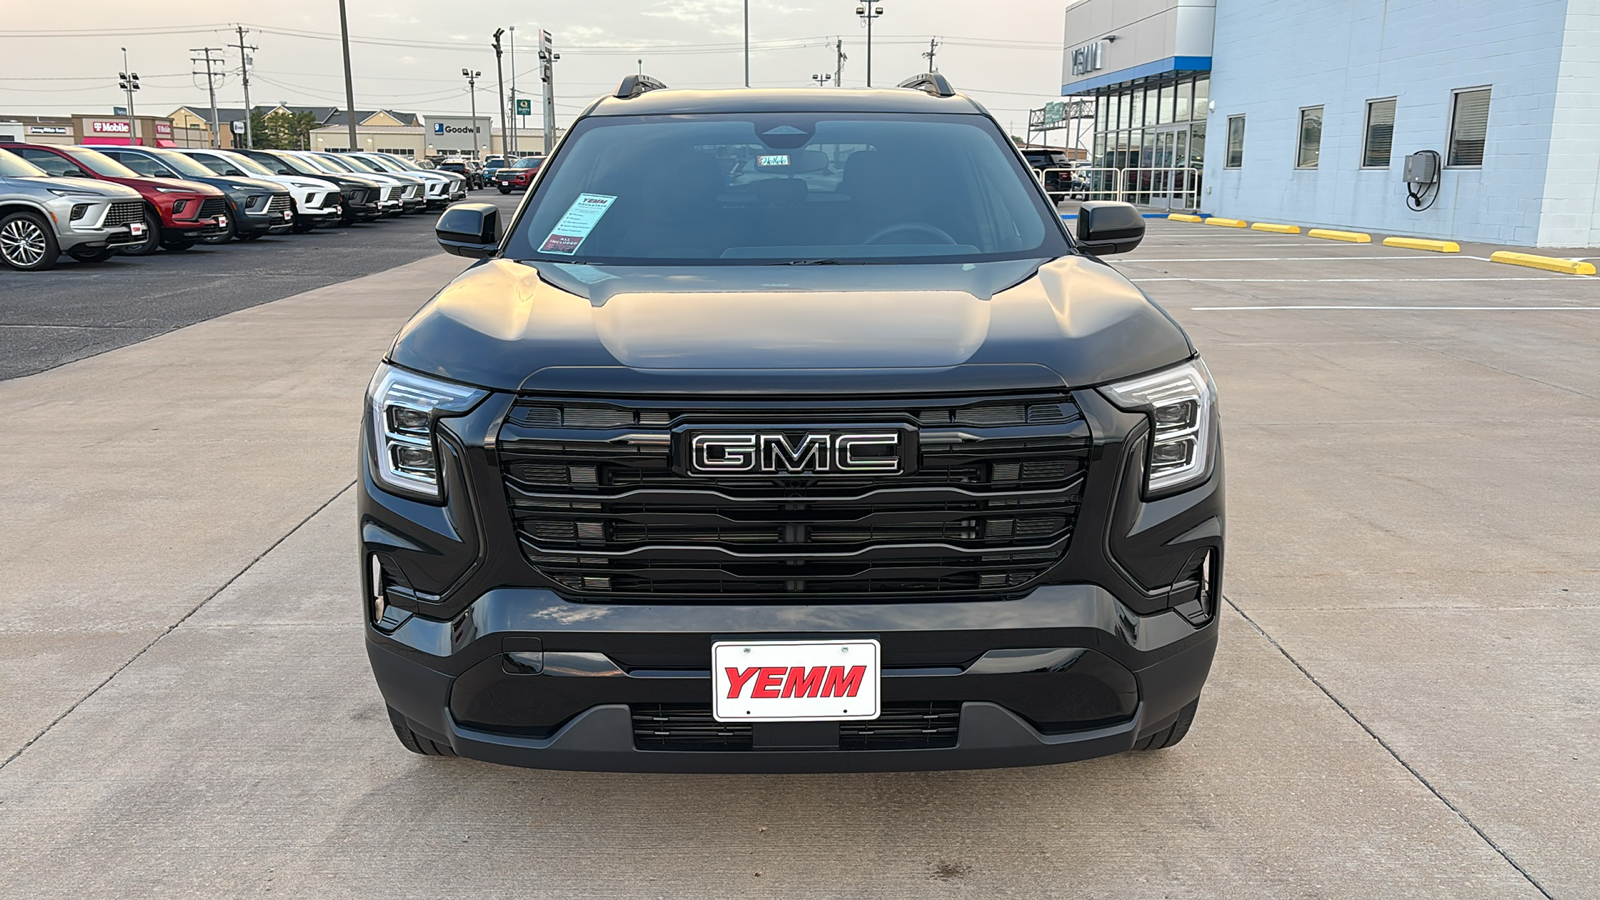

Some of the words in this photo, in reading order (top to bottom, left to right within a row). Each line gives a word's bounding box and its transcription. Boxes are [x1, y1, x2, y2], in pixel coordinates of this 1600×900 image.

[102, 122, 129, 132] Mobile
[445, 125, 480, 133] Goodwll
[692, 433, 898, 471] GMC
[724, 665, 867, 699] YEMM
